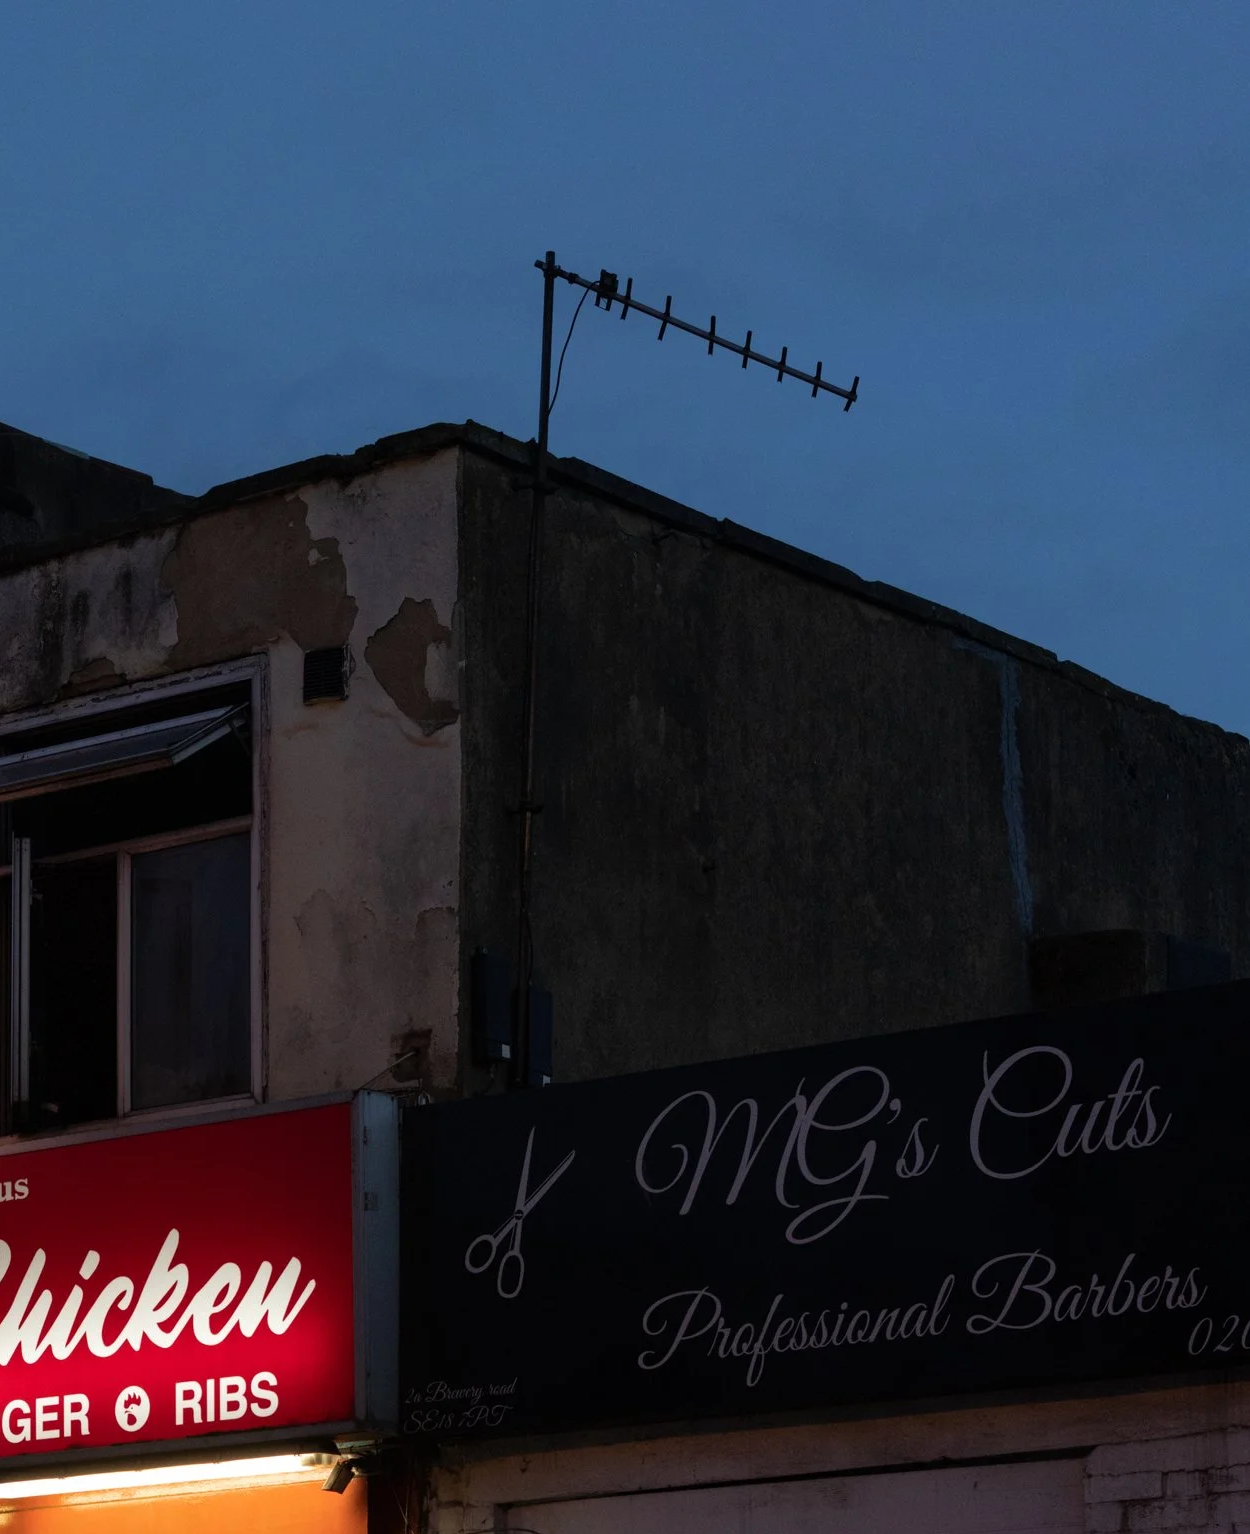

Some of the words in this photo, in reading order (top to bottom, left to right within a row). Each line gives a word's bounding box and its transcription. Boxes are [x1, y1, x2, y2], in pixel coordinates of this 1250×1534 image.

[635, 1065, 940, 1245] MG's
[969, 1045, 1173, 1180] Cuts
[637, 1273, 955, 1388] Professional
[966, 1248, 1208, 1334] Barbers
[174, 1371, 280, 1427] RIBS
[425, 1374, 483, 1405] Brewery
[489, 1376, 518, 1395] road
